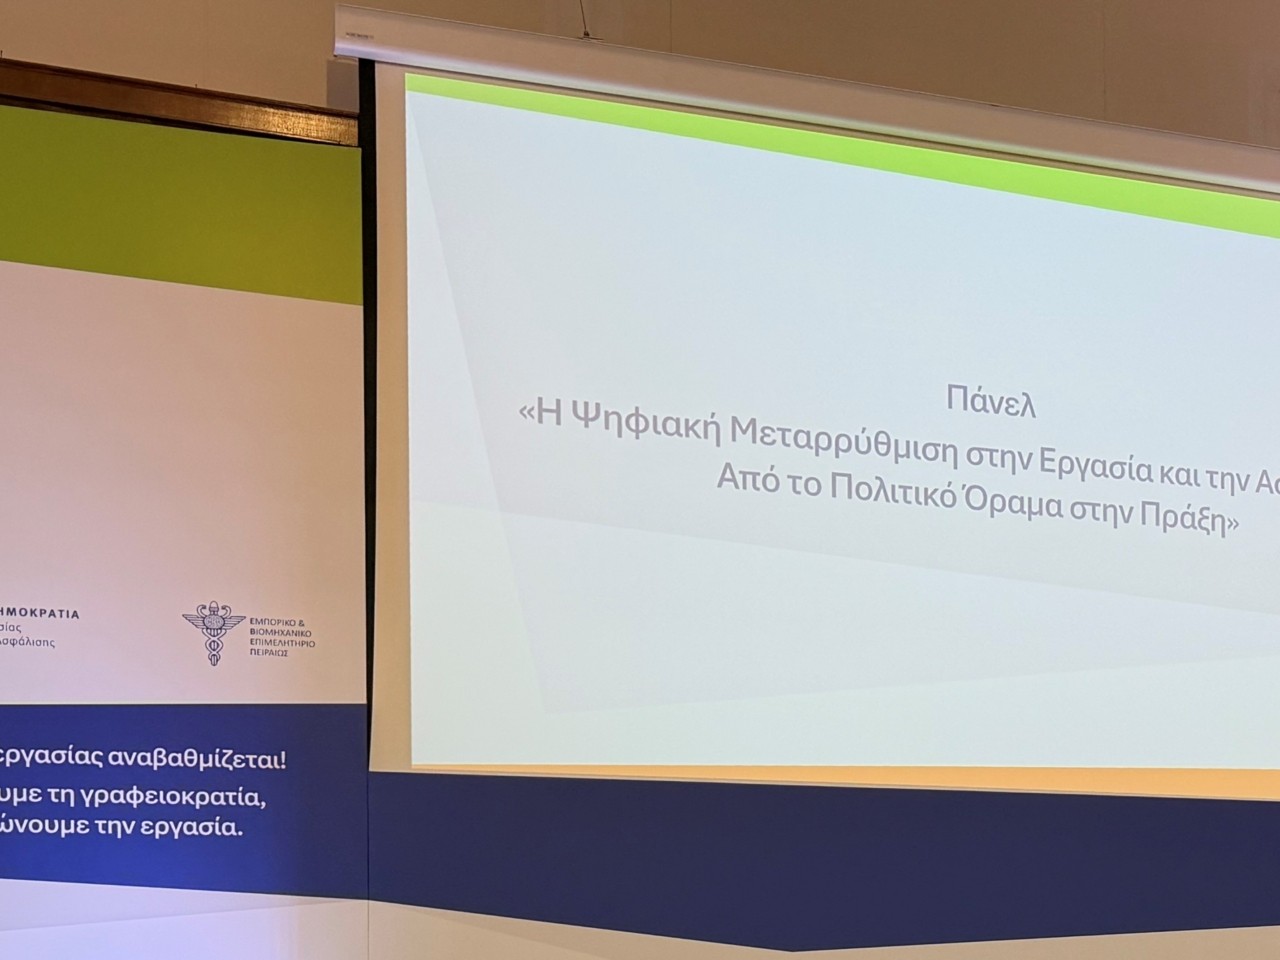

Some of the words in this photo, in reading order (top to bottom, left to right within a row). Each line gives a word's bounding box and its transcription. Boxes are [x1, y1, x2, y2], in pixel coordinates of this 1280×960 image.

[947, 383, 1037, 419] Πάνελ
[518, 397, 562, 426] «Η
[572, 399, 721, 448] Ψηφιακή
[730, 415, 958, 469] Μεταρρύθμιση
[966, 445, 1033, 475] στην
[1040, 446, 1154, 482] Εργασία
[1160, 465, 1200, 487] και
[1205, 470, 1250, 496] την
[717, 462, 780, 493] Από
[787, 473, 822, 497] το
[831, 472, 957, 509] Πολιτικό
[962, 484, 1064, 521] Όραμα
[1070, 502, 1134, 529] στην
[1141, 501, 1240, 538] Πράξη»
[250, 618, 296, 626] ΕΜΠΟΡΙΚΟ
[250, 628, 312, 637] ΒΙΟΜΗΧΑΝΙΚΟ
[0, 637, 55, 649] σφάλισης
[250, 638, 316, 648] ΕΠΙΜΕΛΗΤΗΡΙΟ
[250, 648, 288, 657] ΠΕΙΡΑΙΩΣ
[108, 747, 286, 771] αναβαθμίζεται!
[47, 788, 75, 807] τη
[80, 785, 267, 810] γραφειοκρατία,
[94, 819, 136, 839] την
[140, 816, 243, 840] εργασία.
